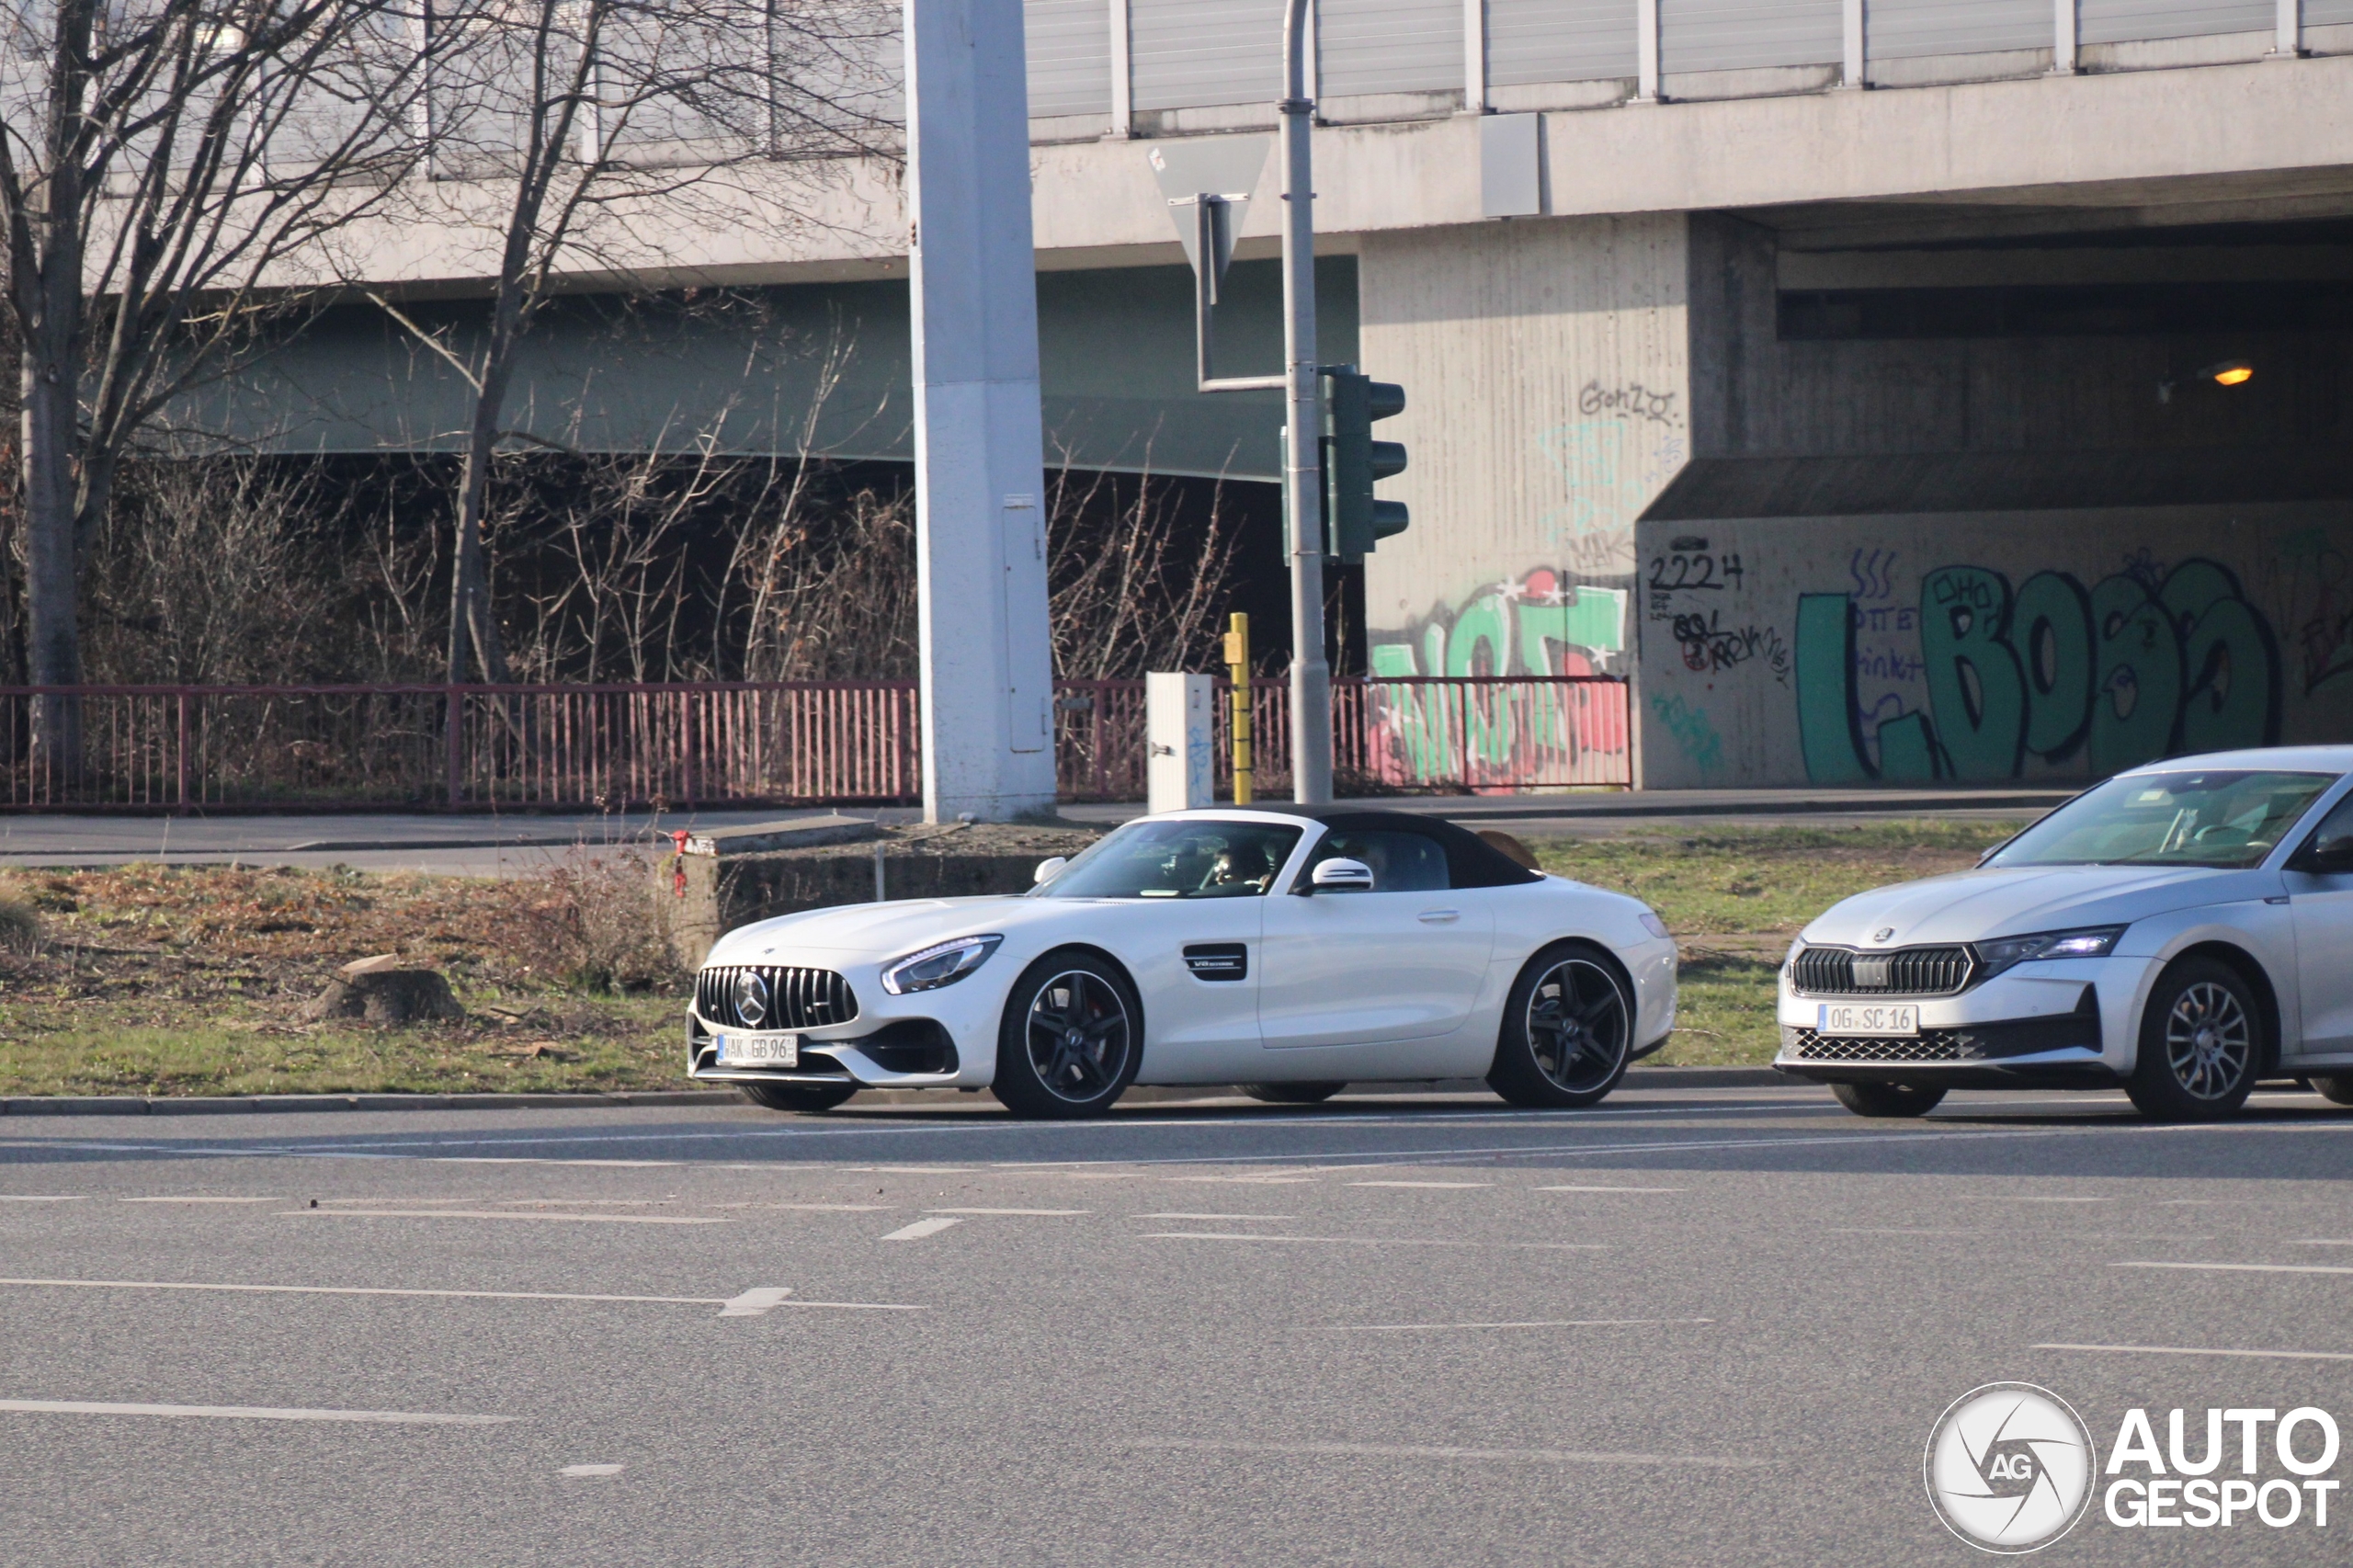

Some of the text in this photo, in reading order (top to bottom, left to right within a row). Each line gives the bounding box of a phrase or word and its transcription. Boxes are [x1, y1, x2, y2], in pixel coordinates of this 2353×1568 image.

[1832, 1007, 1910, 1030] OG SC 16
[752, 1039, 767, 1057] GB
[770, 1039, 786, 1058] 96
